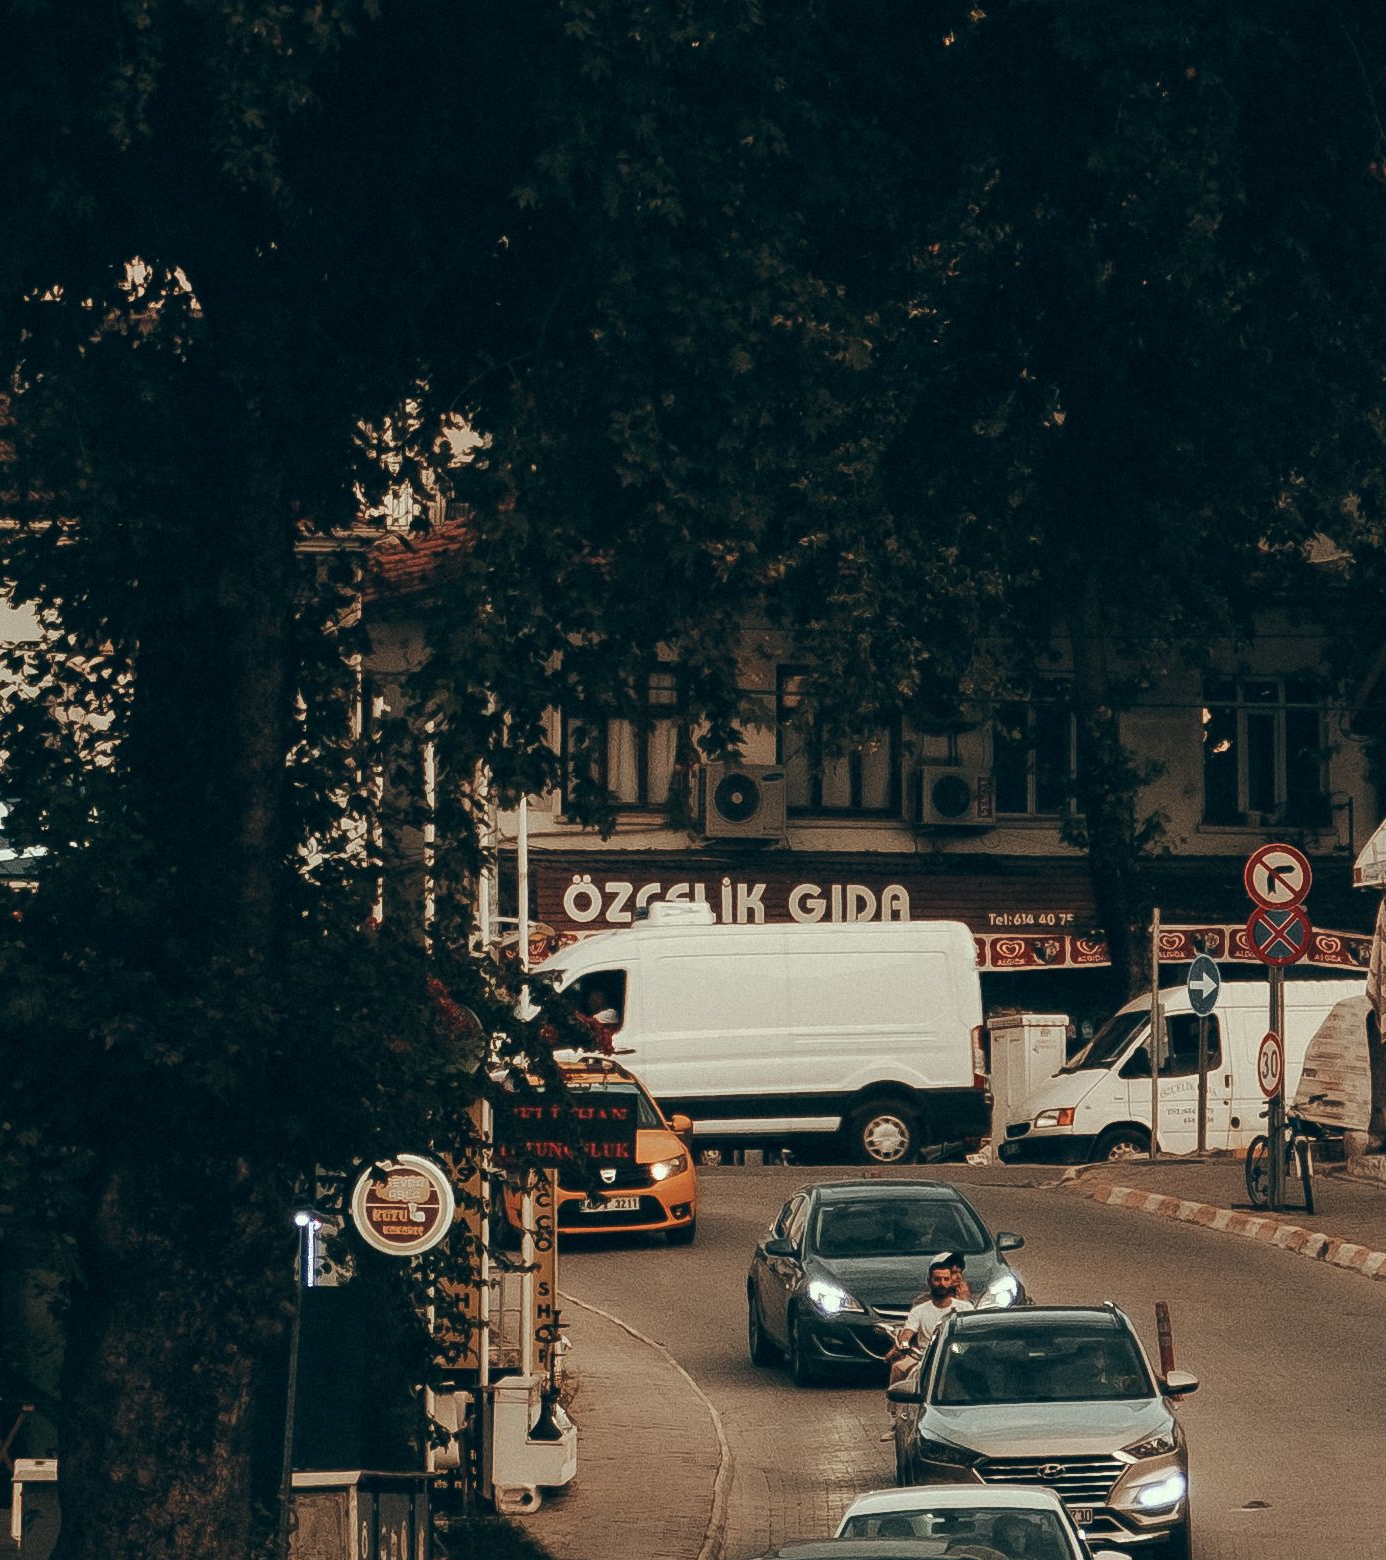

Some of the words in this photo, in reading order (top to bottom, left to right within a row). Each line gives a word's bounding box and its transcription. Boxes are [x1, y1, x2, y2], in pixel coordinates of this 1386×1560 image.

[788, 883, 911, 923] GIDA
[1039, 914, 1055, 926] 40
[1263, 1050, 1278, 1080] 30
[614, 1197, 637, 1209] 3211
